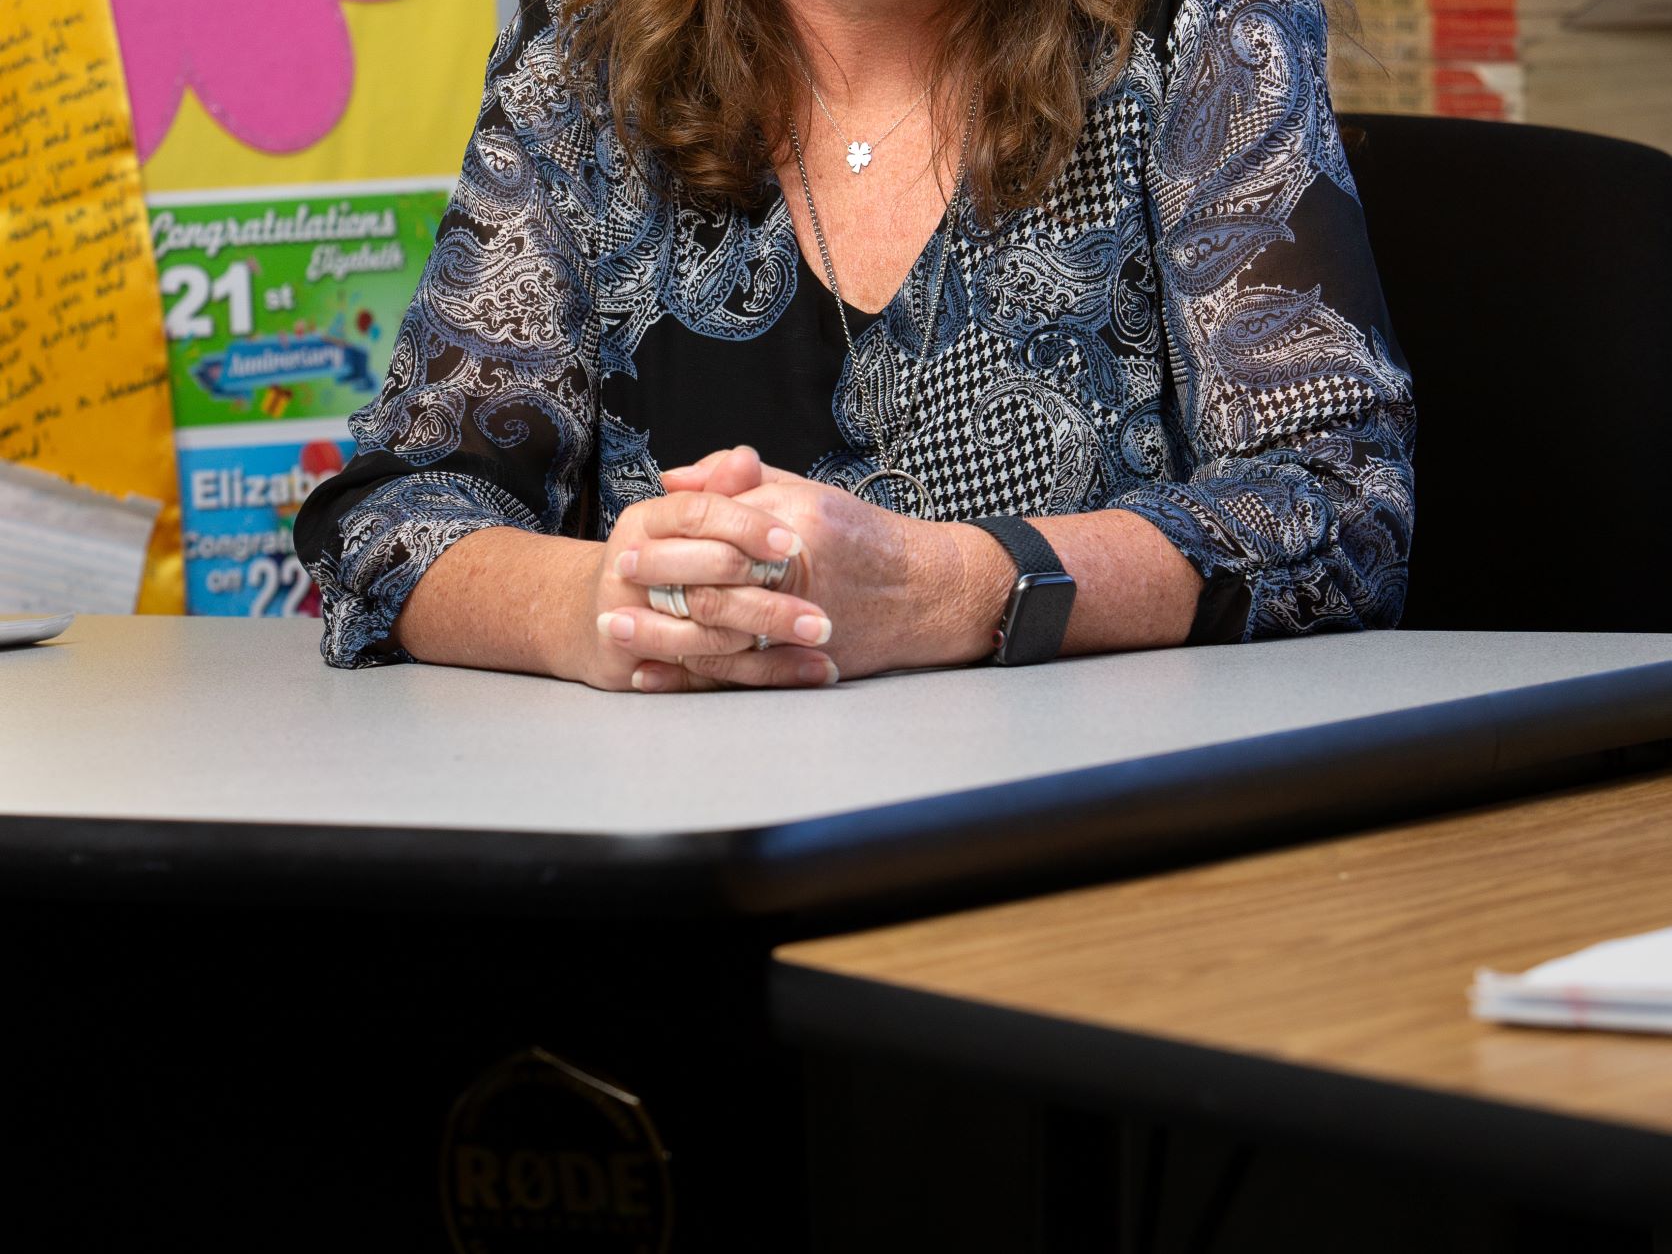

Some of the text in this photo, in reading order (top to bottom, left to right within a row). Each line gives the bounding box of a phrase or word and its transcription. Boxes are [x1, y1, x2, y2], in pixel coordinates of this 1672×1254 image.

[151, 202, 396, 258] Congratulations
[160, 261, 294, 339] 21 st
[192, 464, 336, 509] Elizab
